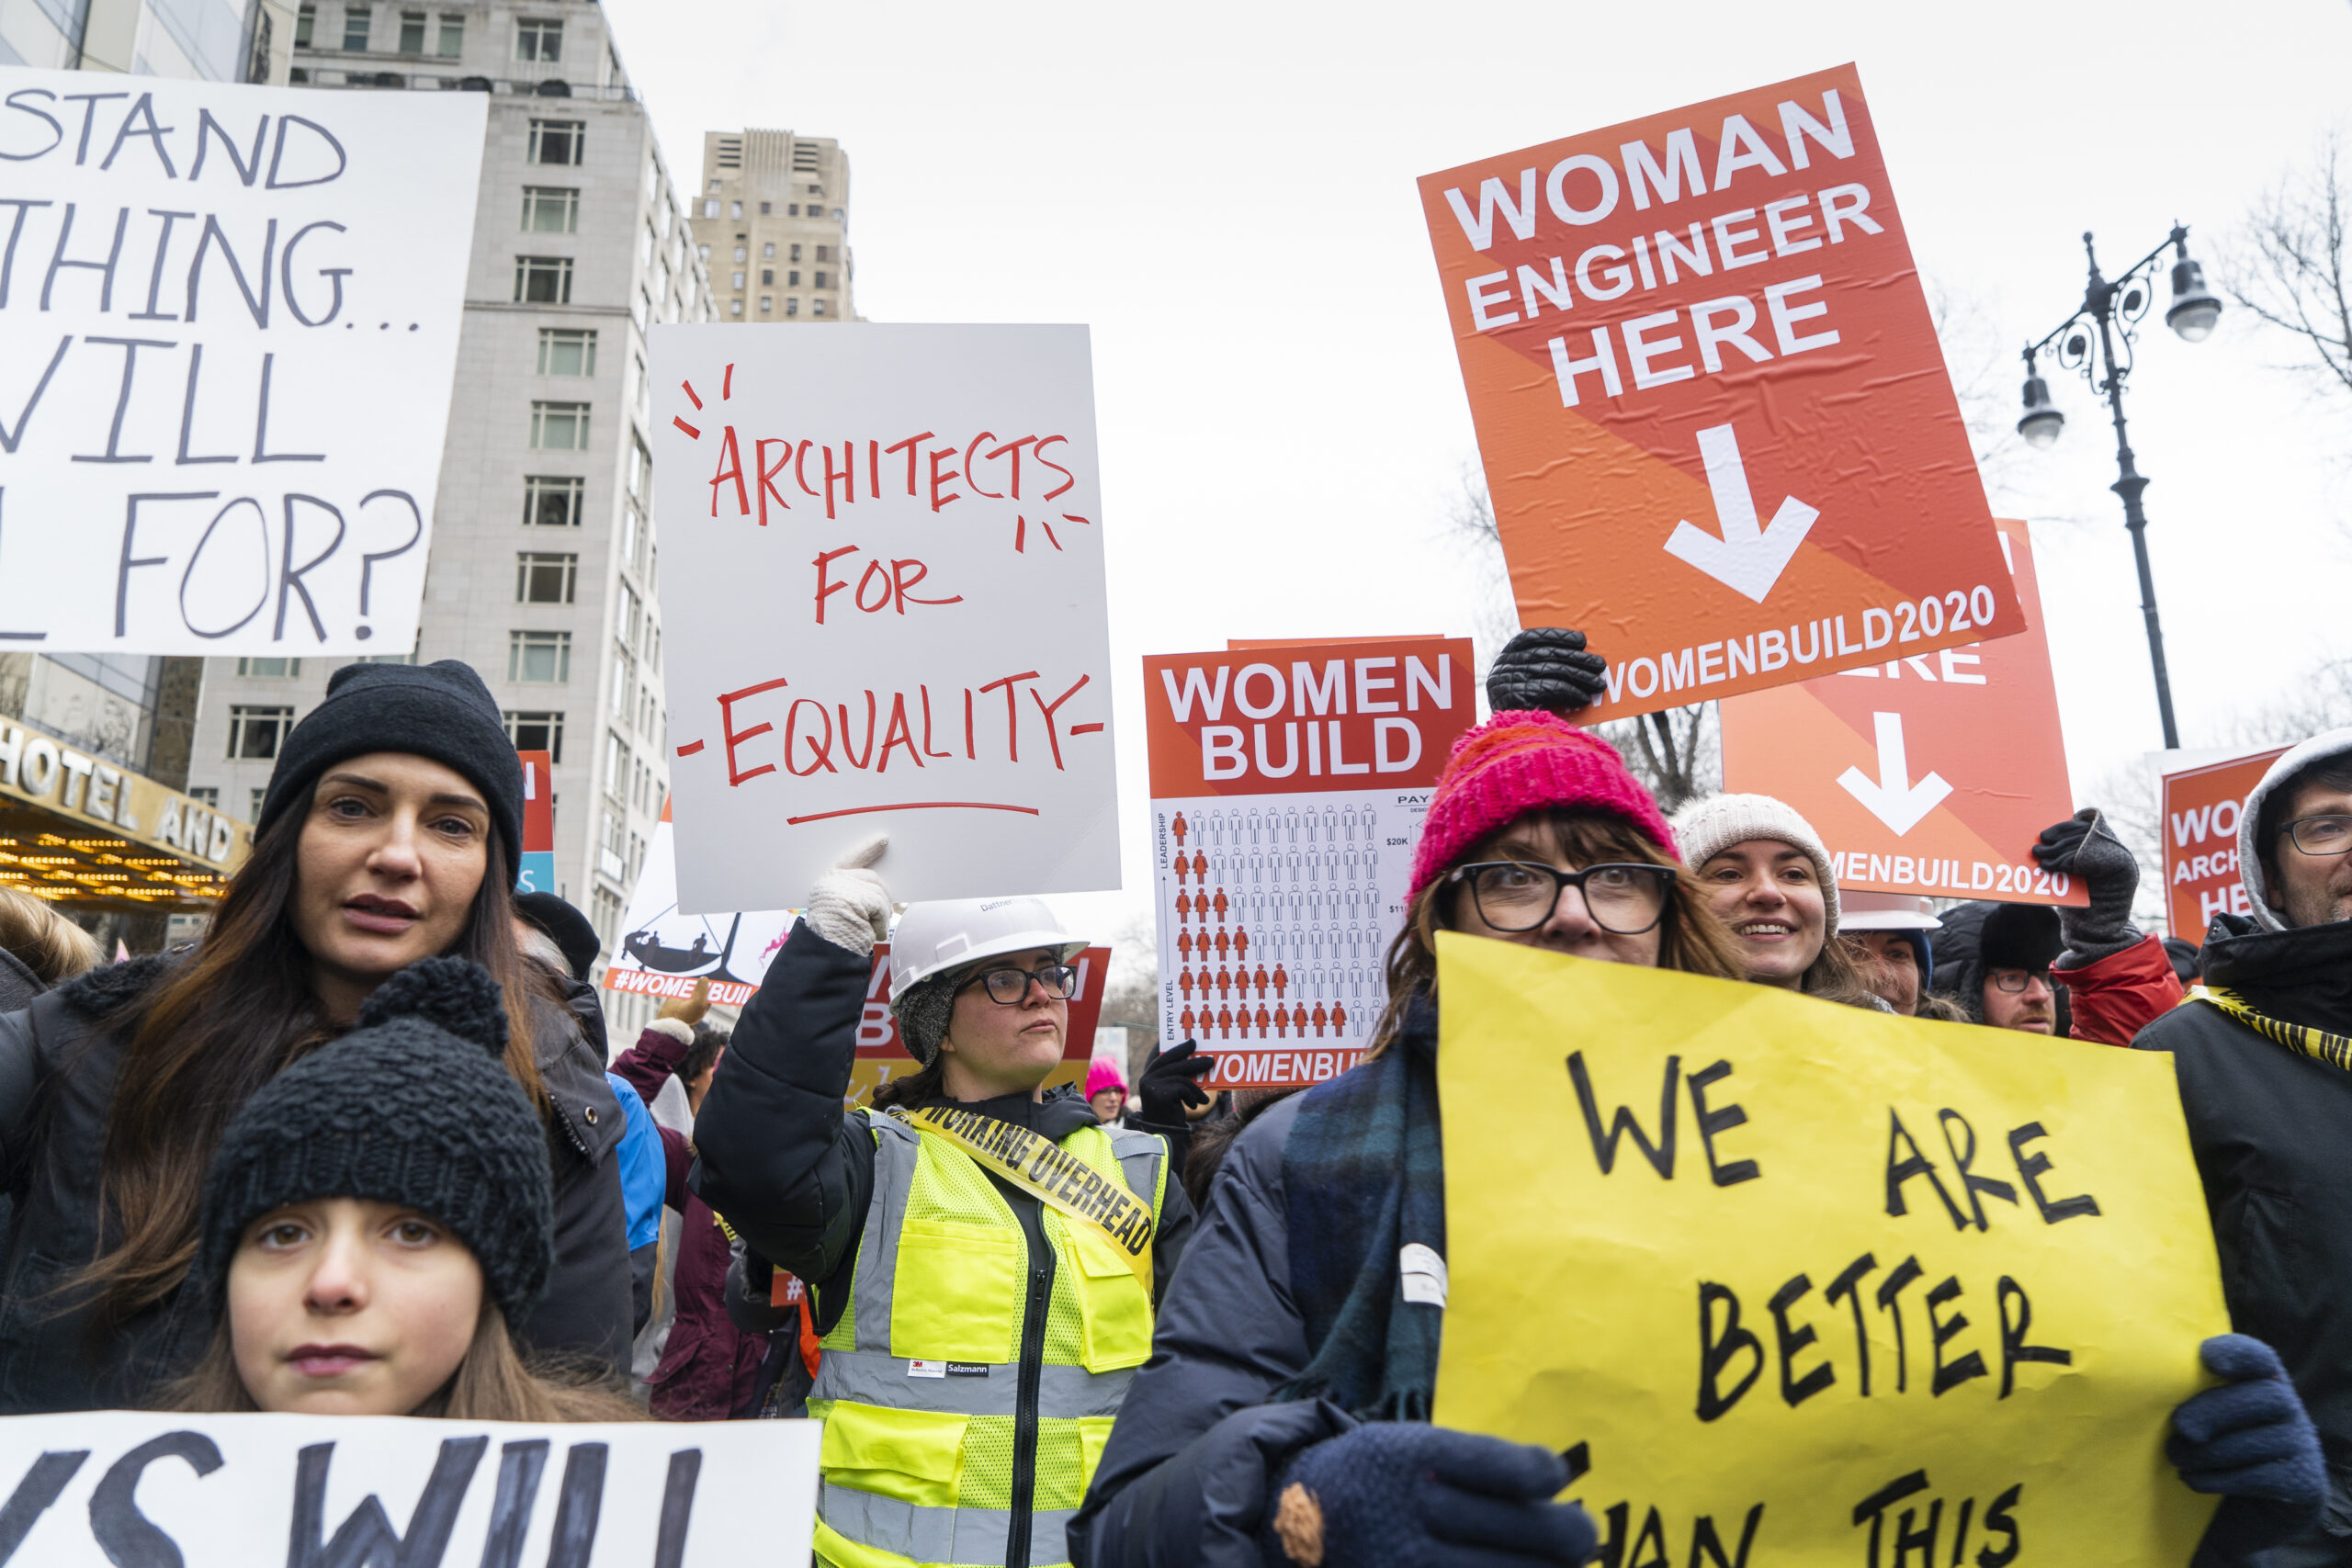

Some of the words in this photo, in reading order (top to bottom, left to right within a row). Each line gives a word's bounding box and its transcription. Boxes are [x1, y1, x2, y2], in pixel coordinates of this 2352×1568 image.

[0, 89, 346, 189] STAND
[1443, 88, 1855, 252] WOMAN
[1464, 183, 1884, 332] ENGINEER
[1547, 274, 1841, 408] HERE
[708, 426, 1075, 526] ARCHITECTS
[115, 489, 422, 643] FOR?
[812, 545, 964, 625] FOR
[1161, 653, 1453, 723] WOMEN
[1590, 584, 1996, 708] WOMENBUILD2020
[0, 720, 138, 831] HOTEL
[154, 795, 234, 863] AND
[1201, 716, 1422, 781] BUILD
[1158, 812, 1168, 869] LEADERSHIP
[1386, 838, 1408, 846] $20K
[1397, 795, 1430, 804] PAY
[2171, 797, 2249, 848] WO
[1389, 905, 1407, 913] $11
[1165, 979, 1173, 1009] LEVEL
[1167, 1010, 1175, 1041] ENTRY
[1566, 1049, 1760, 1188] WE
[1884, 1106, 2102, 1233] ARE
[1028, 1143, 1153, 1257] OVERHEAD
[948, 1364, 988, 1373] Salzmann
[1696, 1251, 2072, 1422] BETTER
[1852, 1470, 2023, 1568] THIS
